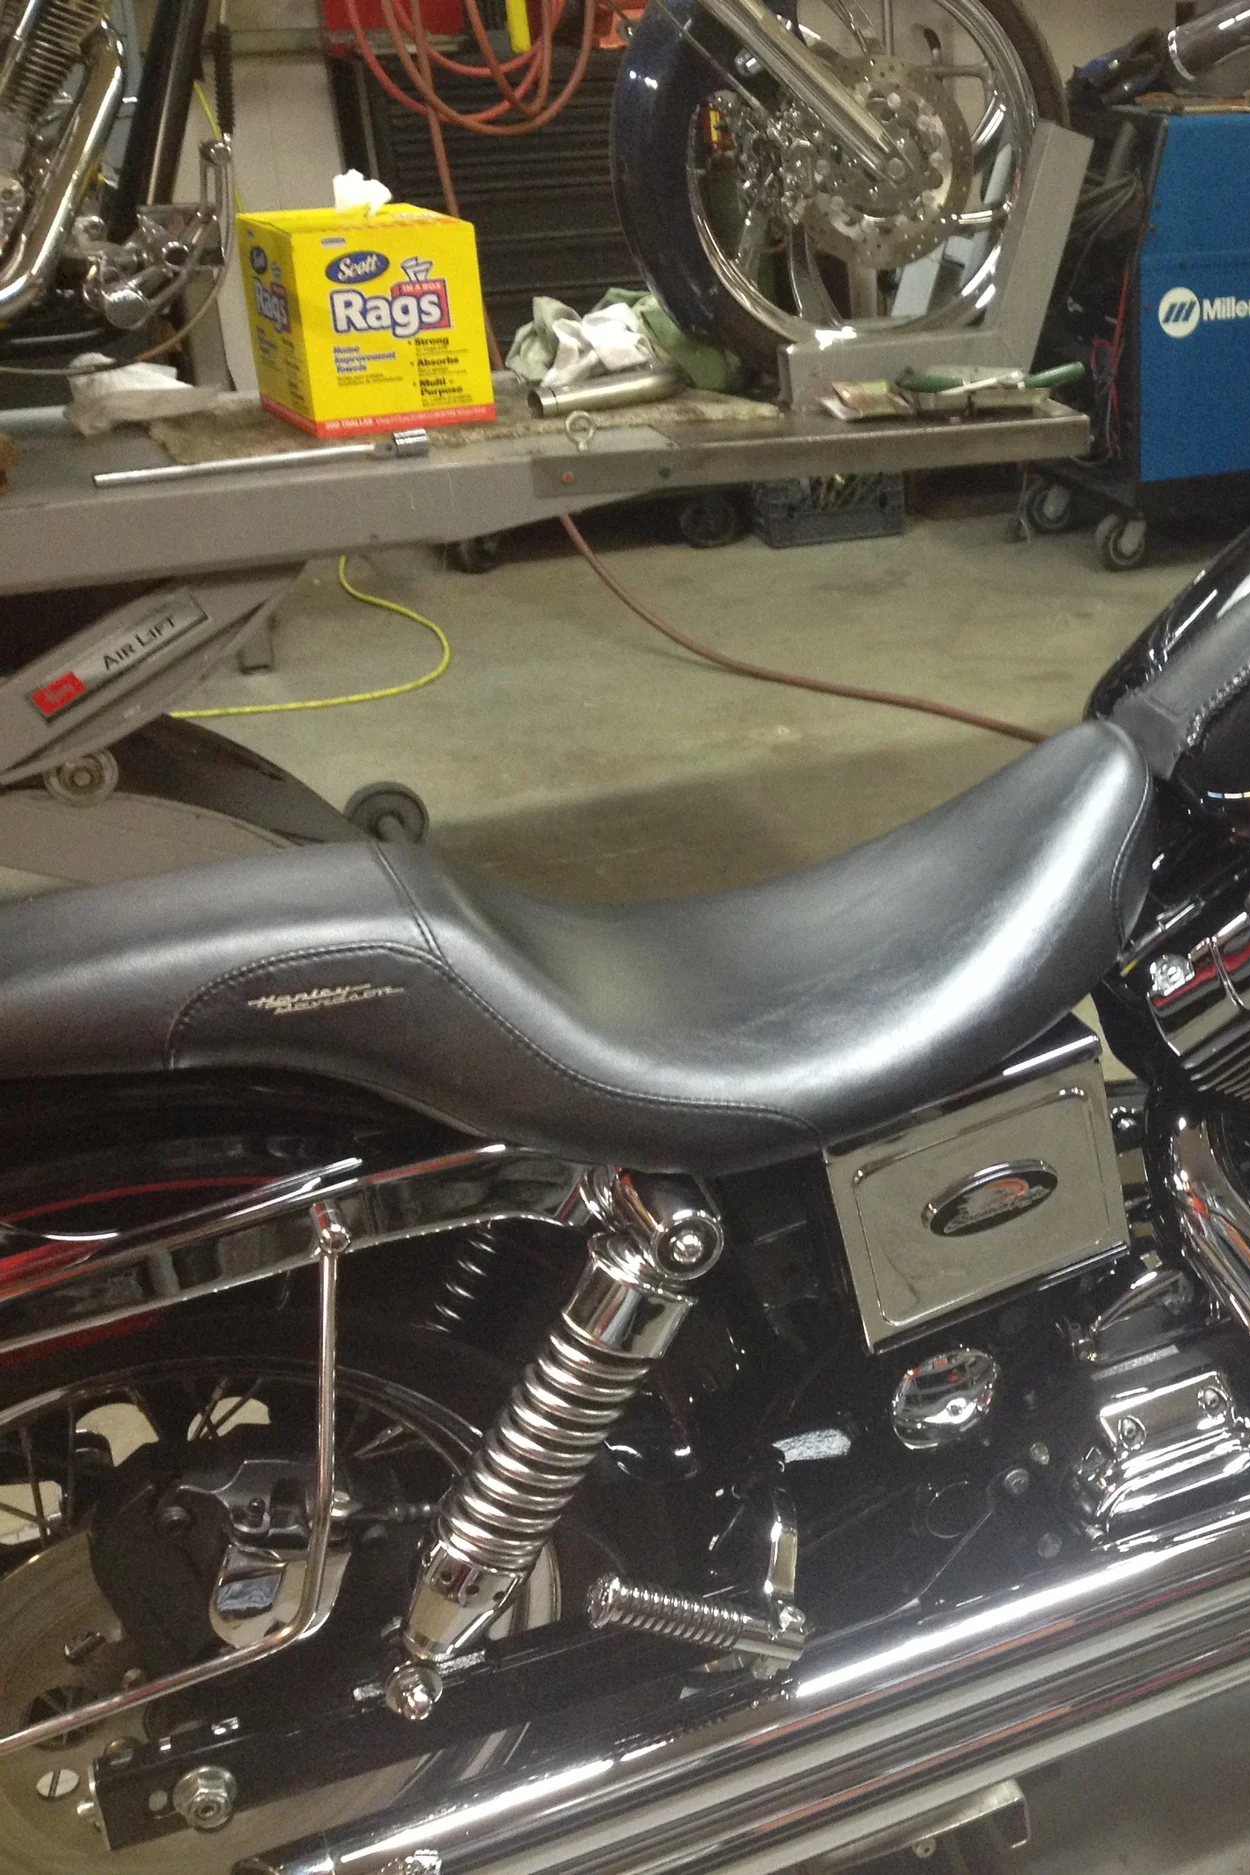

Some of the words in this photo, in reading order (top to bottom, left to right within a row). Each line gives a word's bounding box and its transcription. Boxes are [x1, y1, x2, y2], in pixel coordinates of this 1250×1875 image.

[337, 253, 379, 281] Scott
[402, 284, 413, 293] IN
[330, 289, 443, 338] Rags
